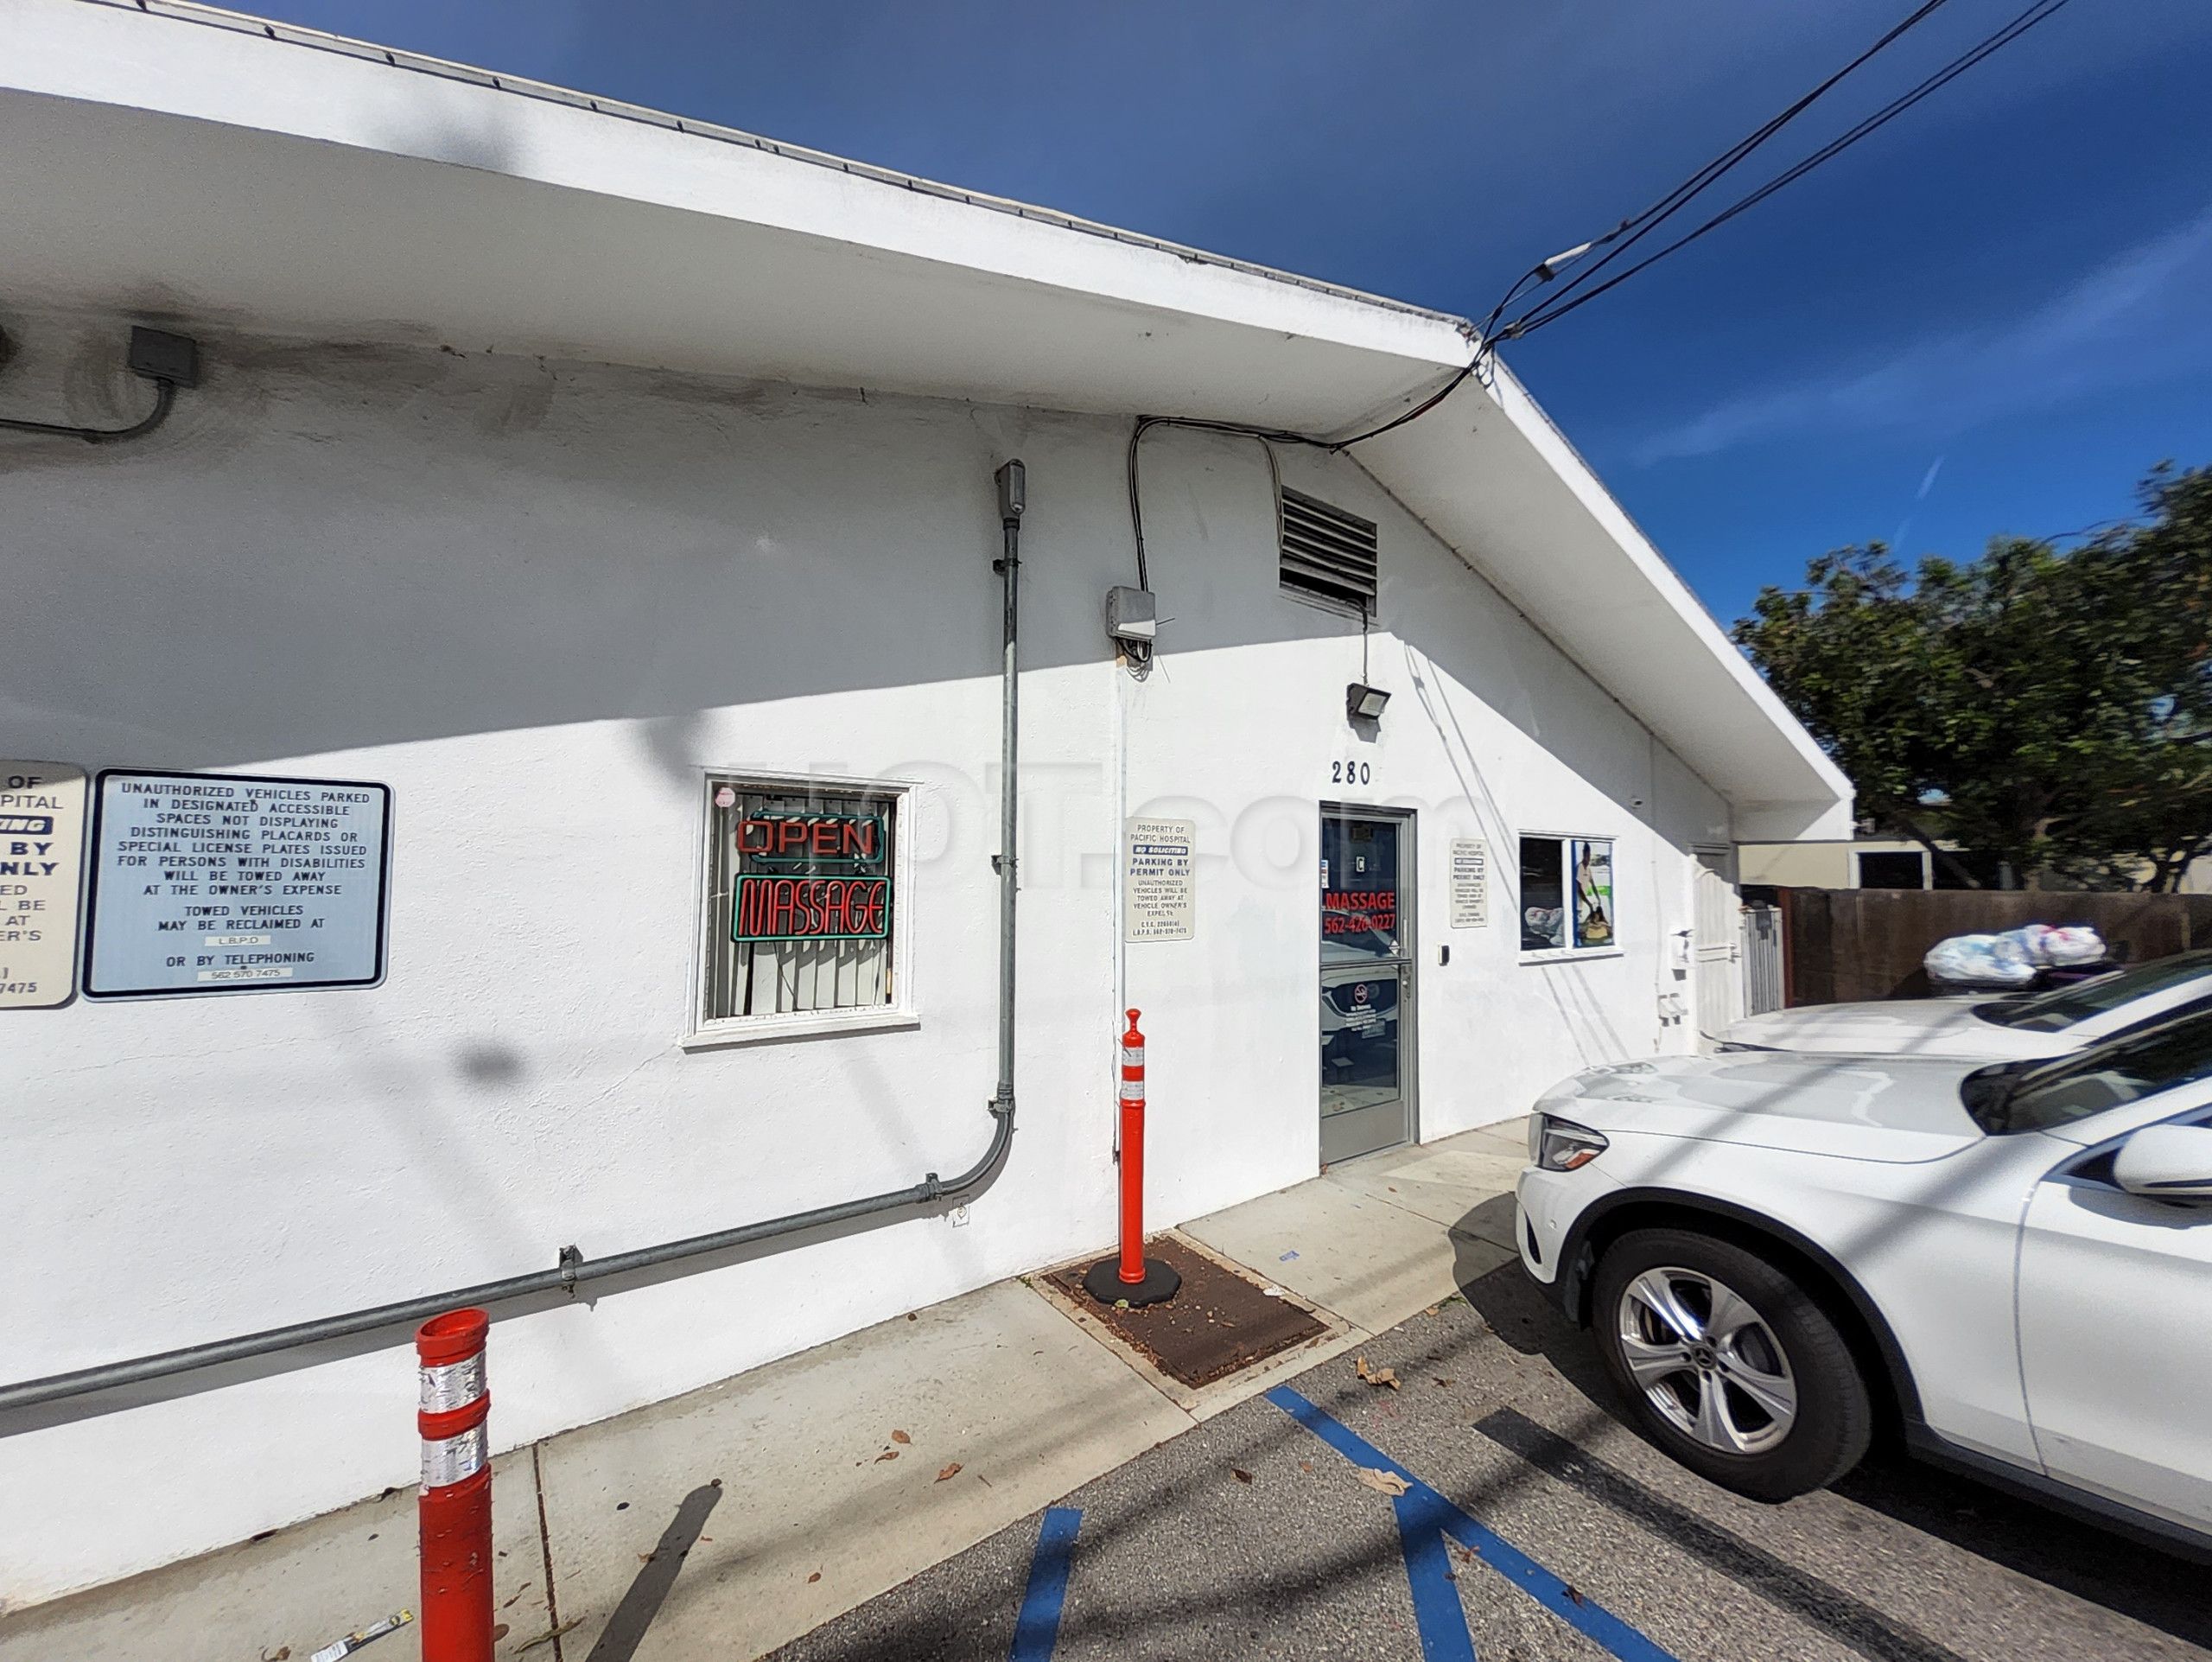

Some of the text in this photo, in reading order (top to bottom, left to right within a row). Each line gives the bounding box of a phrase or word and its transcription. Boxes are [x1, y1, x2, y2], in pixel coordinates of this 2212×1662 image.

[1332, 761, 1370, 785] 280
[8, 775, 41, 789] OF
[122, 782, 370, 804] UNAUTHORIZED VEHICLES PARKED
[0, 794, 64, 809] PITAL
[143, 799, 350, 816] IN DESIGNATED ACCESSIBLE
[156, 813, 339, 829] SPACES NOT DISPLAYING
[130, 827, 358, 842] DISTINGUISHING PLACARDS OR
[737, 819, 873, 854] OPEN
[1160, 835, 1191, 844] HOSPITAL
[10, 842, 54, 856] BY
[118, 841, 367, 856] SPECIAL LICENSE PLATES ISSUED
[0, 862, 60, 876] NLY
[118, 856, 365, 869] FOR PERSONS WITH DISABILITIES
[164, 871, 326, 881] WILL BE TOWED AWAY
[143, 885, 342, 895] AT THE OWNER'S EXPENSE
[18, 900, 46, 910] BE
[738, 879, 886, 936] MASSAGE
[1326, 892, 1395, 909] MASSAGE
[185, 905, 303, 916] TOWED VEHICLES
[4, 915, 31, 926] AT
[158, 919, 325, 931] MAY BE RECLAIMED AT
[0, 930, 42, 941] ER'S
[166, 952, 315, 967] OR BY TELEPHONING
